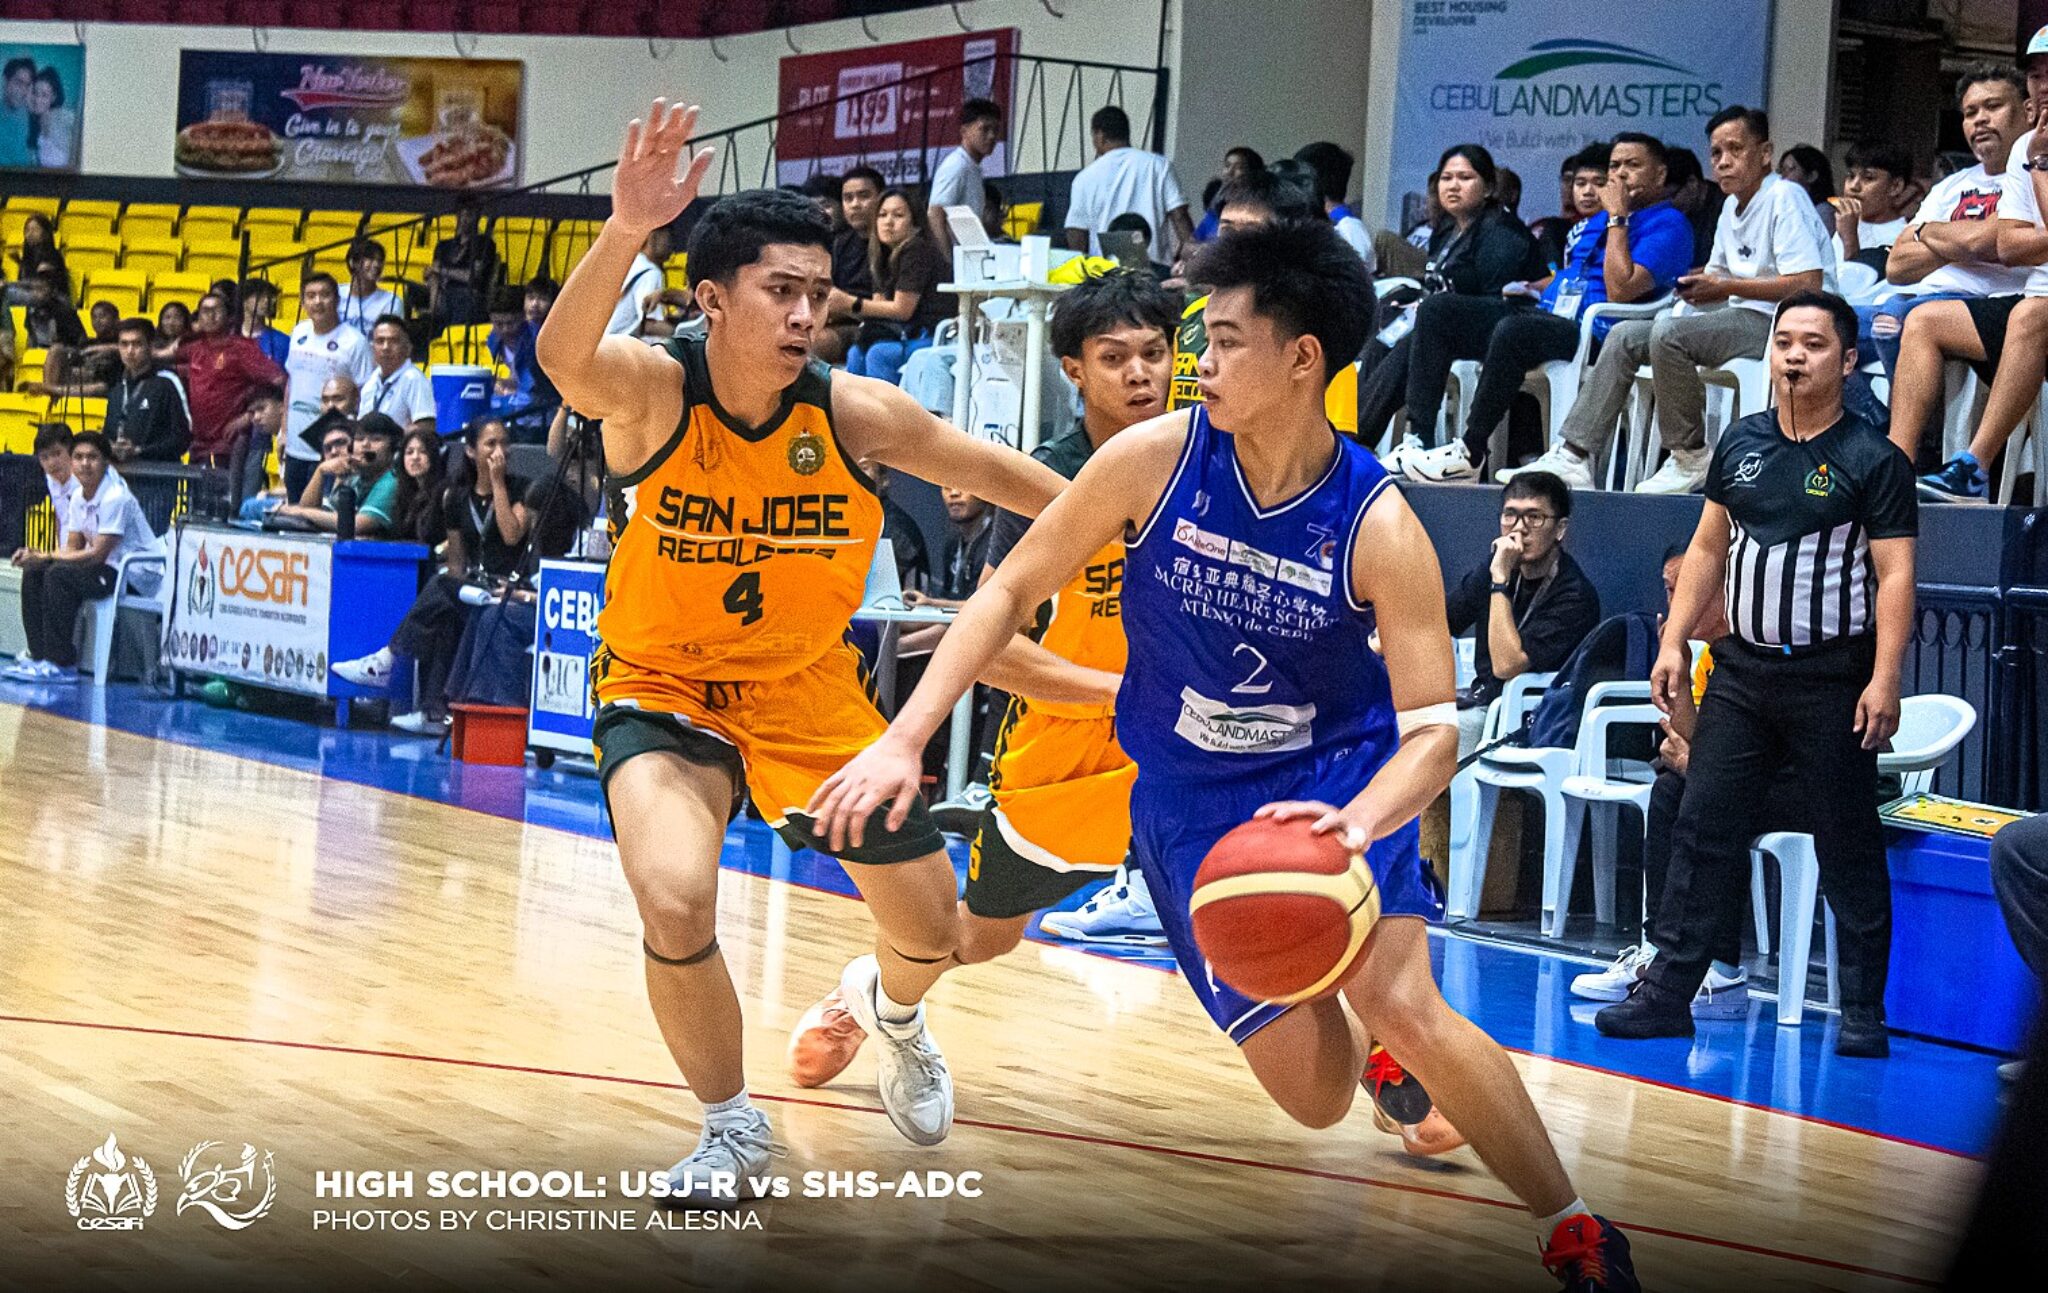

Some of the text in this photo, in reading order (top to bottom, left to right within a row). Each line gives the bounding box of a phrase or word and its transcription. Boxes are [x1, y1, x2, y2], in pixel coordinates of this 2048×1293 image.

[656, 486, 850, 537] SAN JOSE
[722, 571, 764, 627] 4
[1230, 643, 1273, 693] 2
